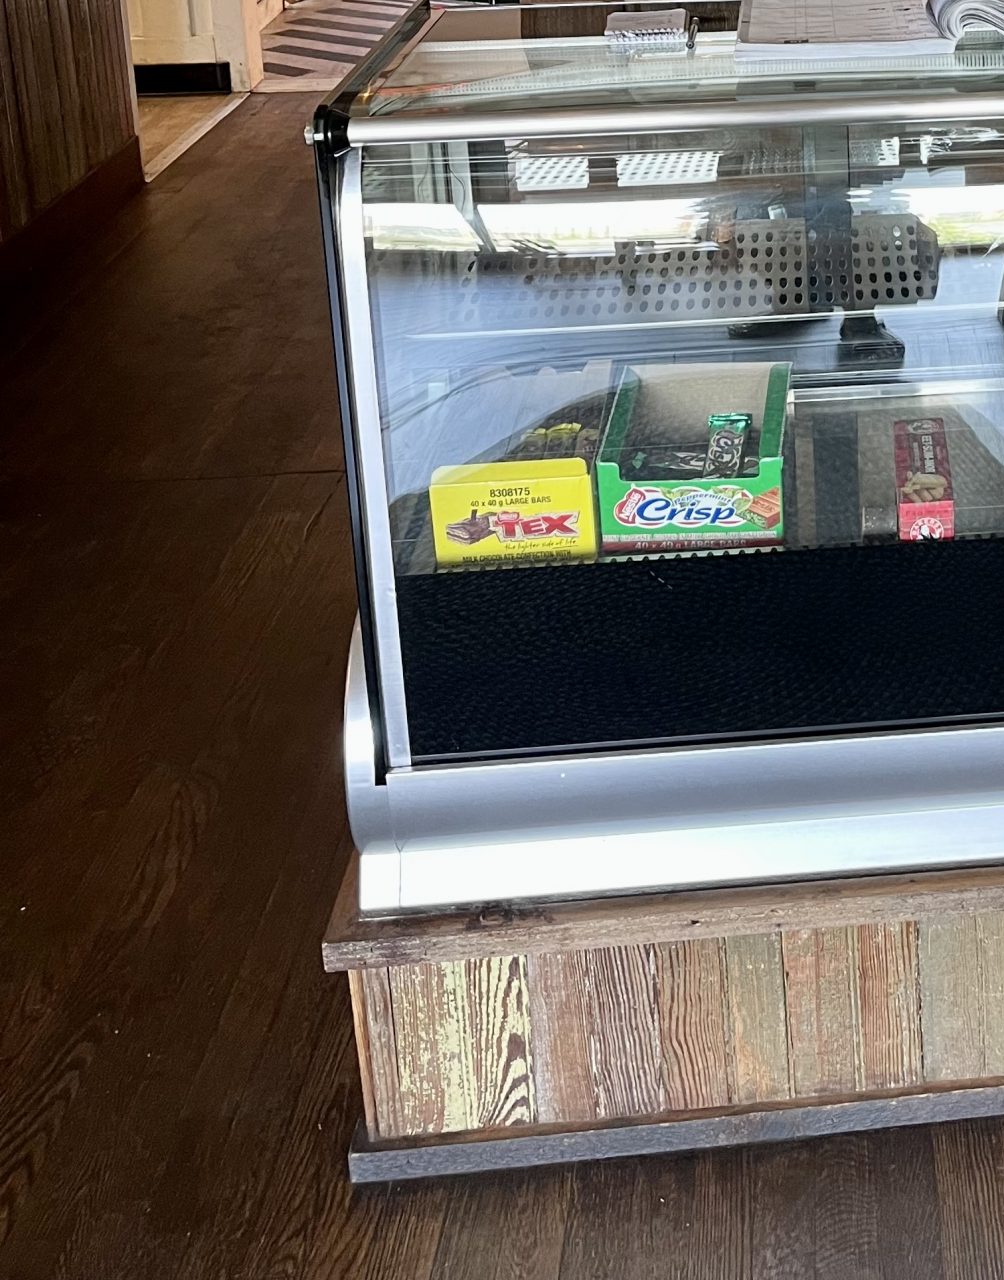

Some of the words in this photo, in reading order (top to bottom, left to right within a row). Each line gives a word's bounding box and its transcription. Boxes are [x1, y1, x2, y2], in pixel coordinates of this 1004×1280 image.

[489, 486, 531, 498] 8308175
[487, 499, 497, 507] 40
[505, 497, 529, 506] LARGE
[531, 495, 552, 504] BARS
[673, 493, 732, 507] peppermint
[636, 497, 736, 524] Crisp
[494, 513, 580, 539] TEX
[517, 541, 539, 552] lighter
[565, 538, 577, 546] life
[684, 540, 717, 549] LARGE
[719, 539, 747, 548] BARS
